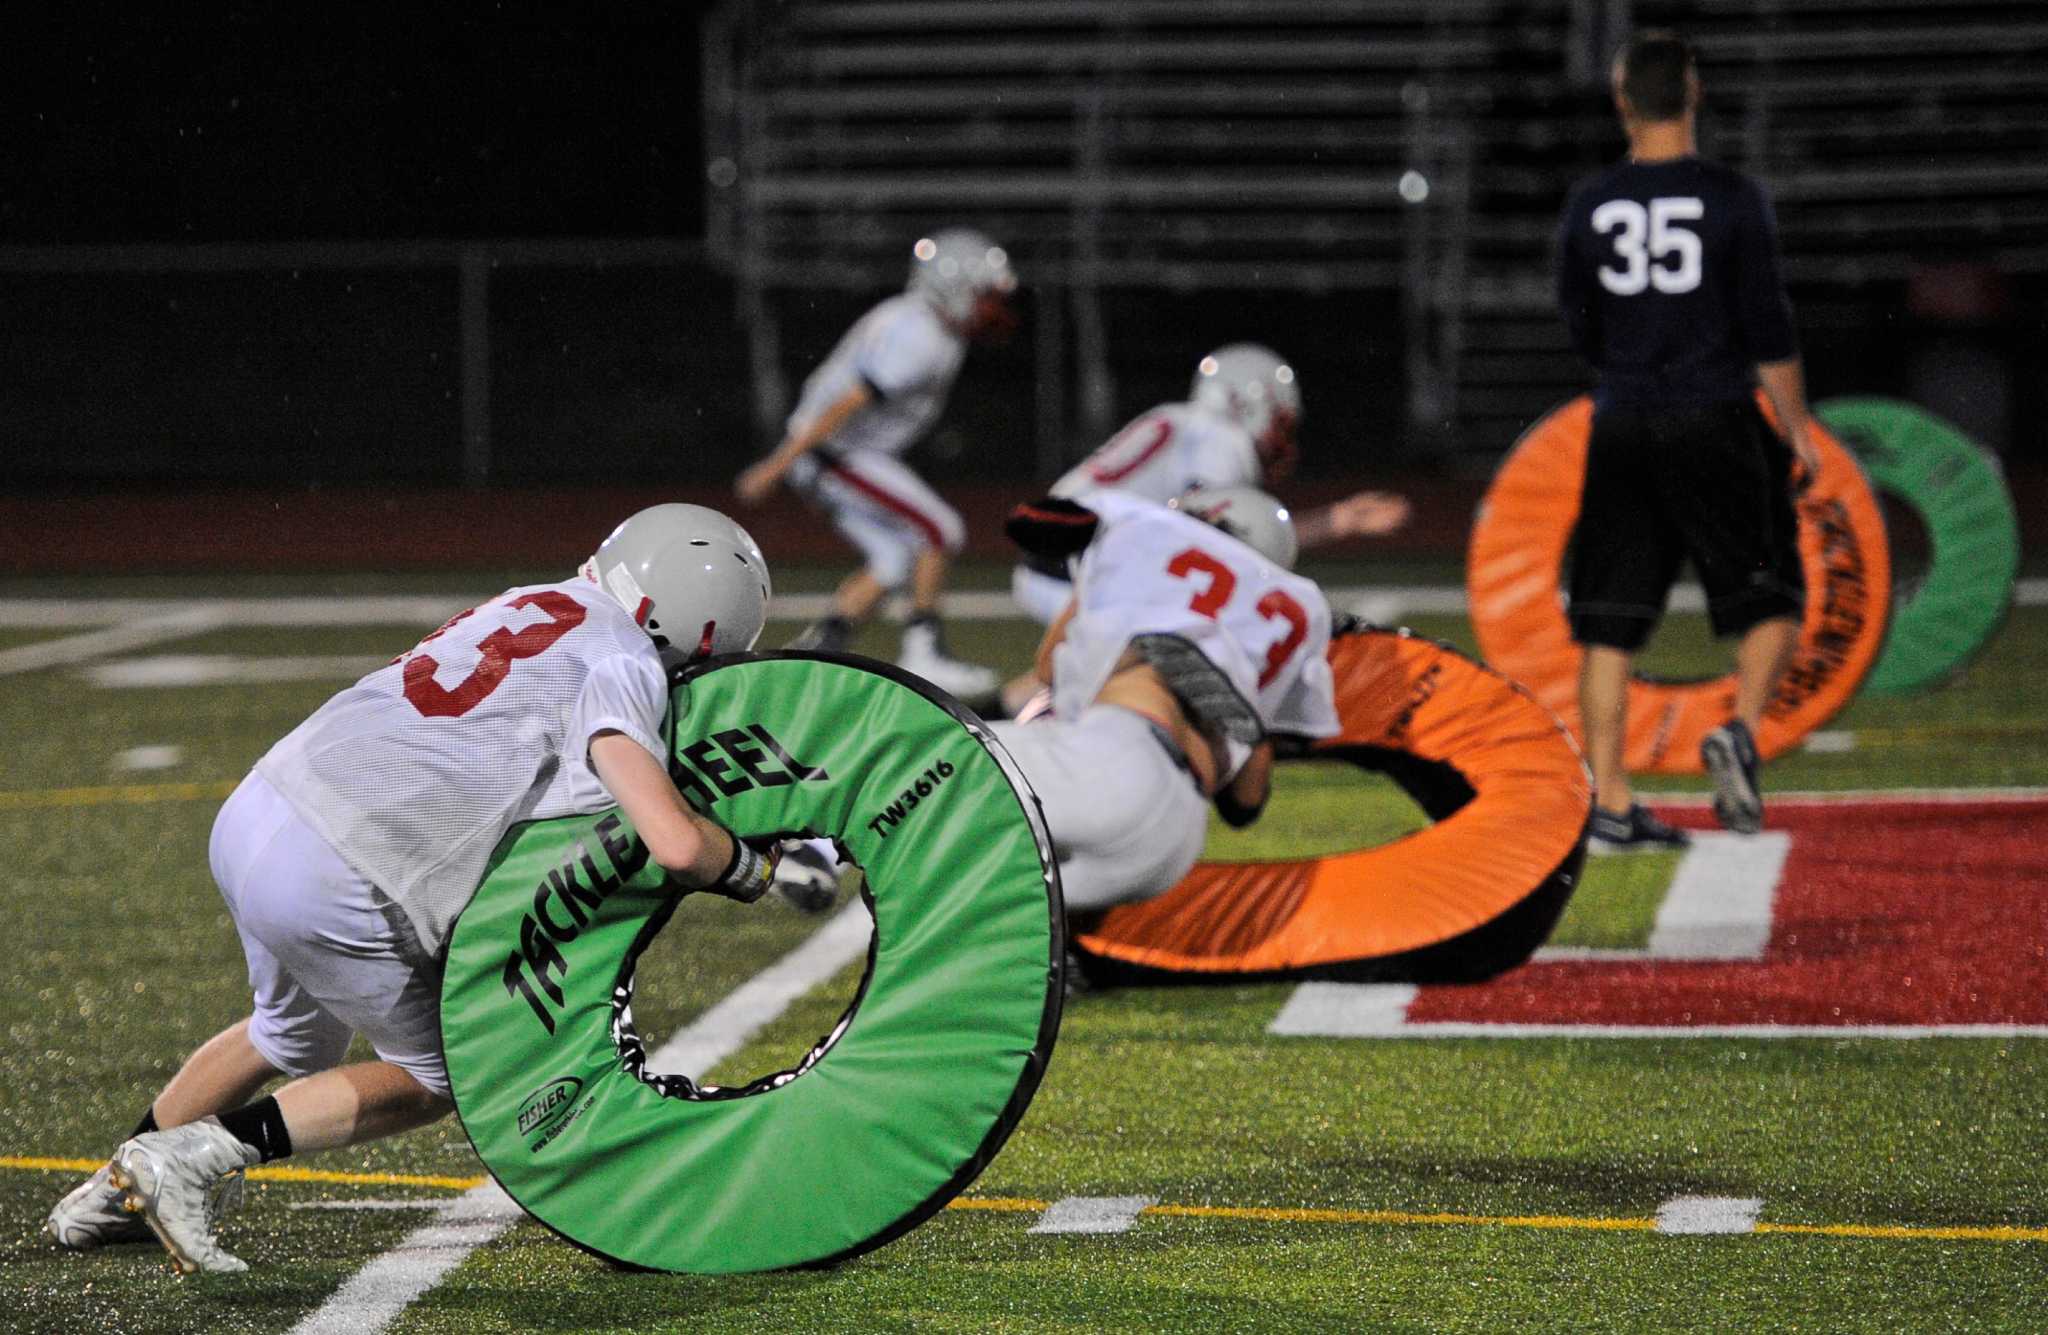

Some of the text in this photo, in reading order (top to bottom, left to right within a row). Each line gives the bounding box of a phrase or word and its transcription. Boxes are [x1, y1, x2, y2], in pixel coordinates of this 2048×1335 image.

[1591, 197, 1704, 296] 35
[868, 759, 954, 838] TW3616
[502, 724, 829, 1036] TACKLE HEEL
[518, 1085, 567, 1132] FISHER
